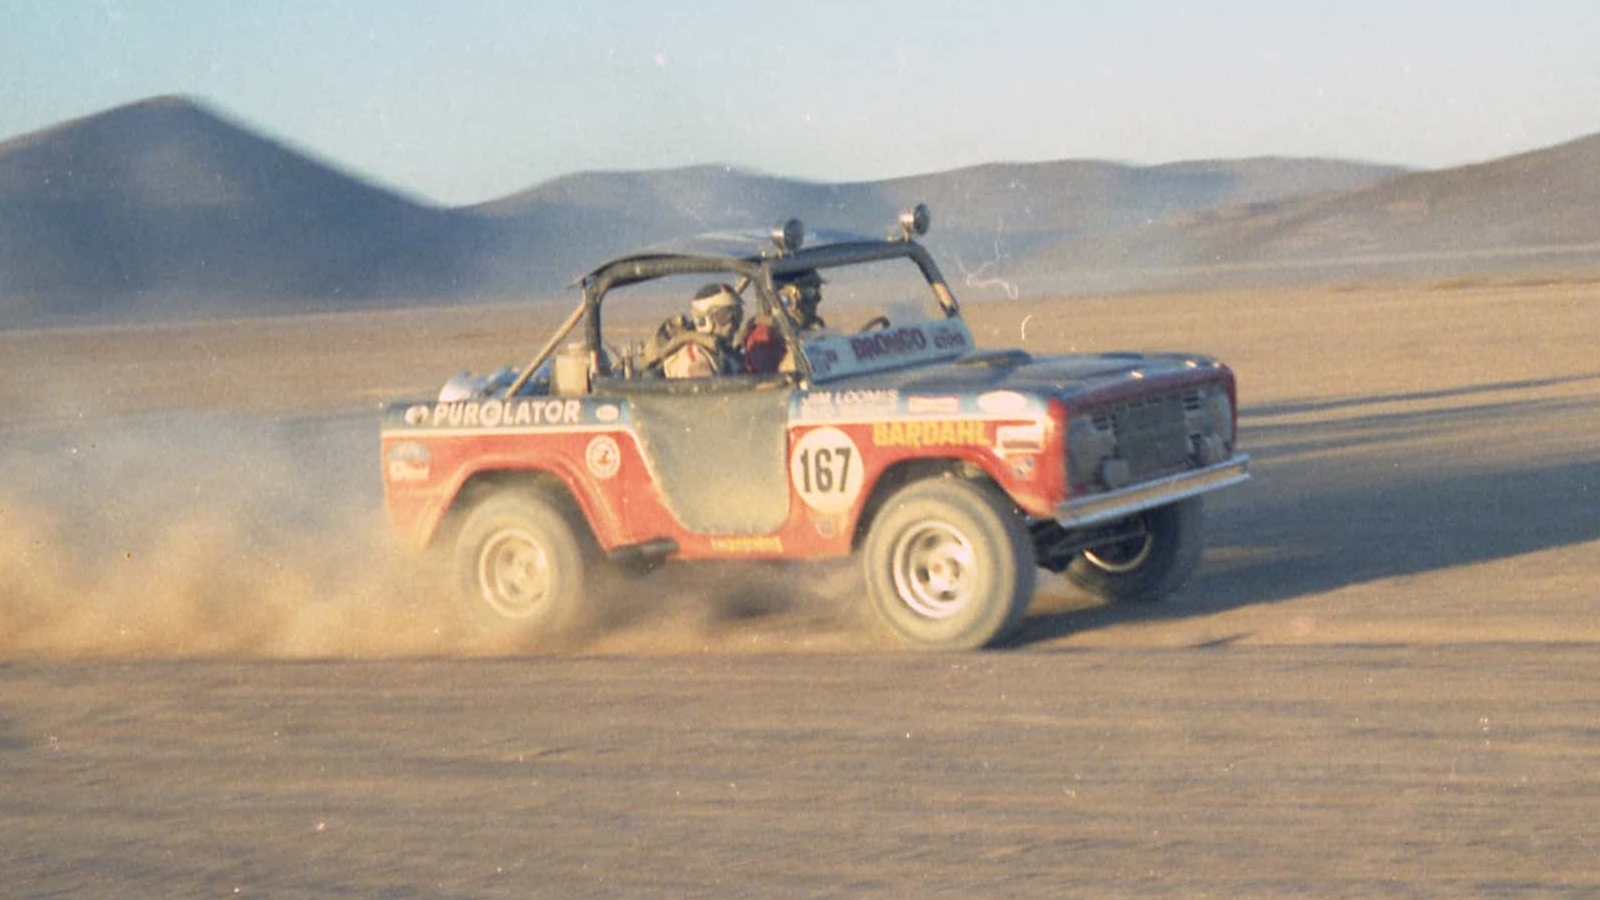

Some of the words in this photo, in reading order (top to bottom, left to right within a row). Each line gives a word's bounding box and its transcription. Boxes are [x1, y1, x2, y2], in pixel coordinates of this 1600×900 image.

[851, 328, 927, 360] BRONCO
[433, 400, 581, 427] PUROLATOR
[873, 419, 991, 447] BARDAHL
[799, 448, 852, 493] 167
